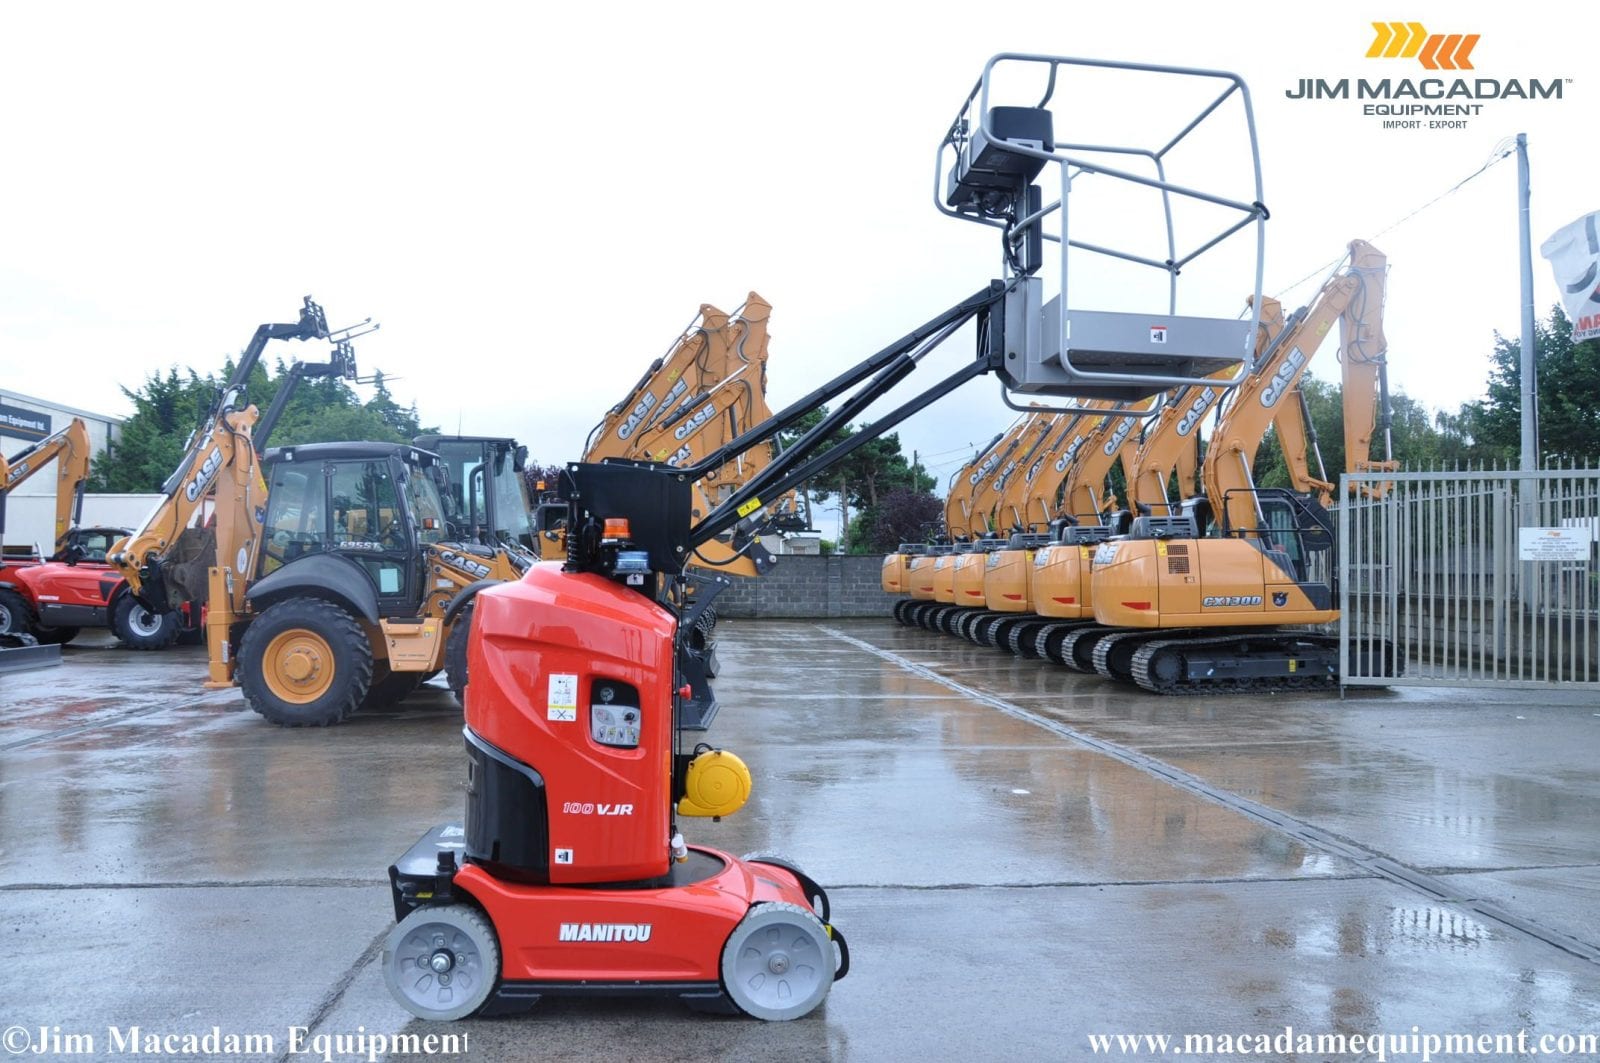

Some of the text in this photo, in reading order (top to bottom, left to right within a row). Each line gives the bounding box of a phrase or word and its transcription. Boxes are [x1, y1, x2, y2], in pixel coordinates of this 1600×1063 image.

[1260, 345, 1307, 408] CASE
[617, 390, 657, 440] CASE
[674, 402, 716, 440] CASE
[1176, 386, 1217, 436] CASE
[1055, 434, 1085, 472] CASE
[1104, 416, 1137, 456] CASE
[8, 462, 29, 482] ASE
[187, 445, 223, 502] CASE
[970, 452, 1000, 485] CASE
[441, 550, 492, 578] CASE
[563, 802, 634, 816] 100 VJR
[559, 924, 652, 942] MANITOU
